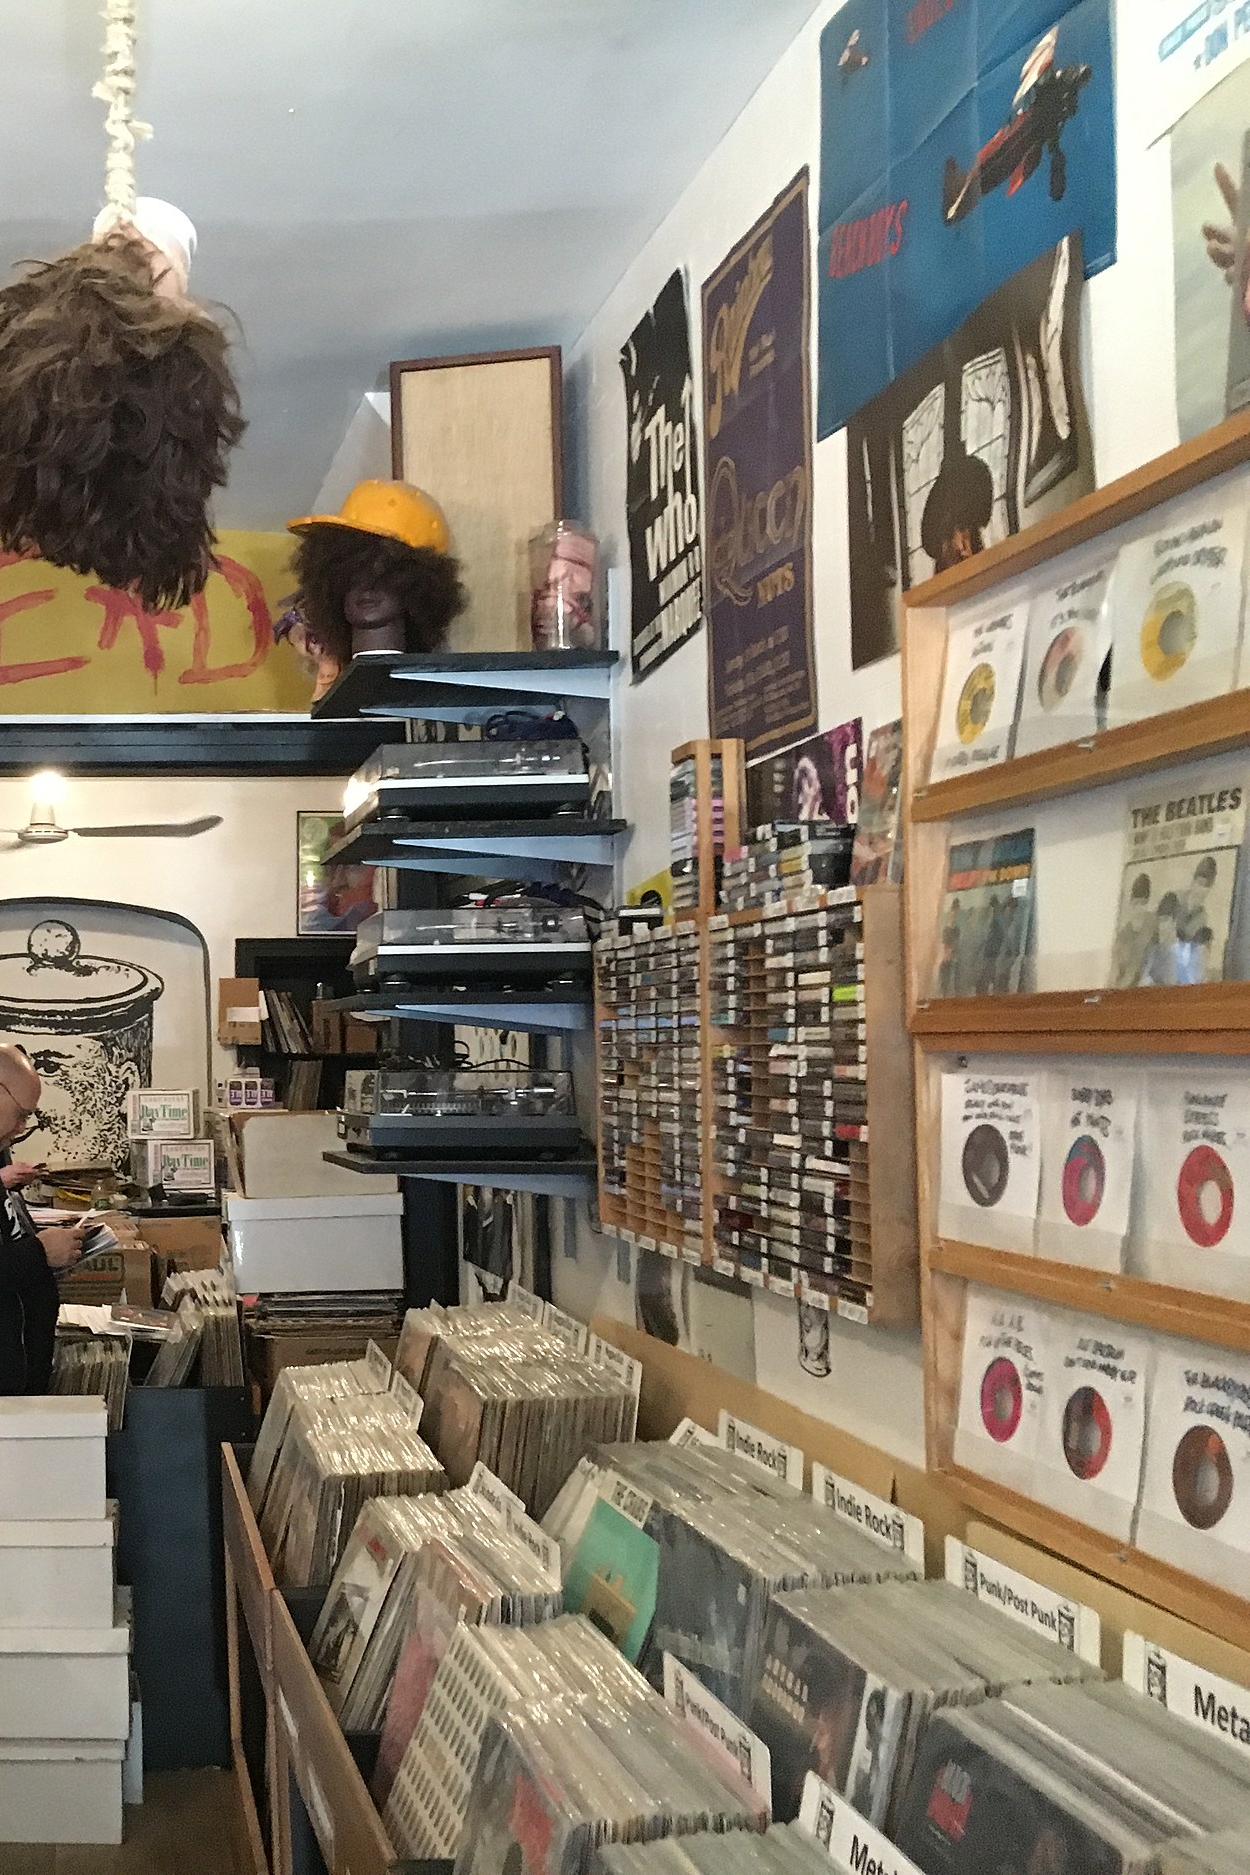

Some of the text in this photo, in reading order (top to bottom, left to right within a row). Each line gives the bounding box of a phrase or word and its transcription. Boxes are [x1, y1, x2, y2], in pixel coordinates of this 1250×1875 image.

[645, 403, 684, 501] The
[1131, 787, 1243, 829] THE BEATLES
[735, 1427, 779, 1470] Indie Rock
[836, 1488, 894, 1539] Indie Rock
[980, 1572, 1058, 1632] Punk/Post Punk
[850, 1834, 898, 1875] Met
